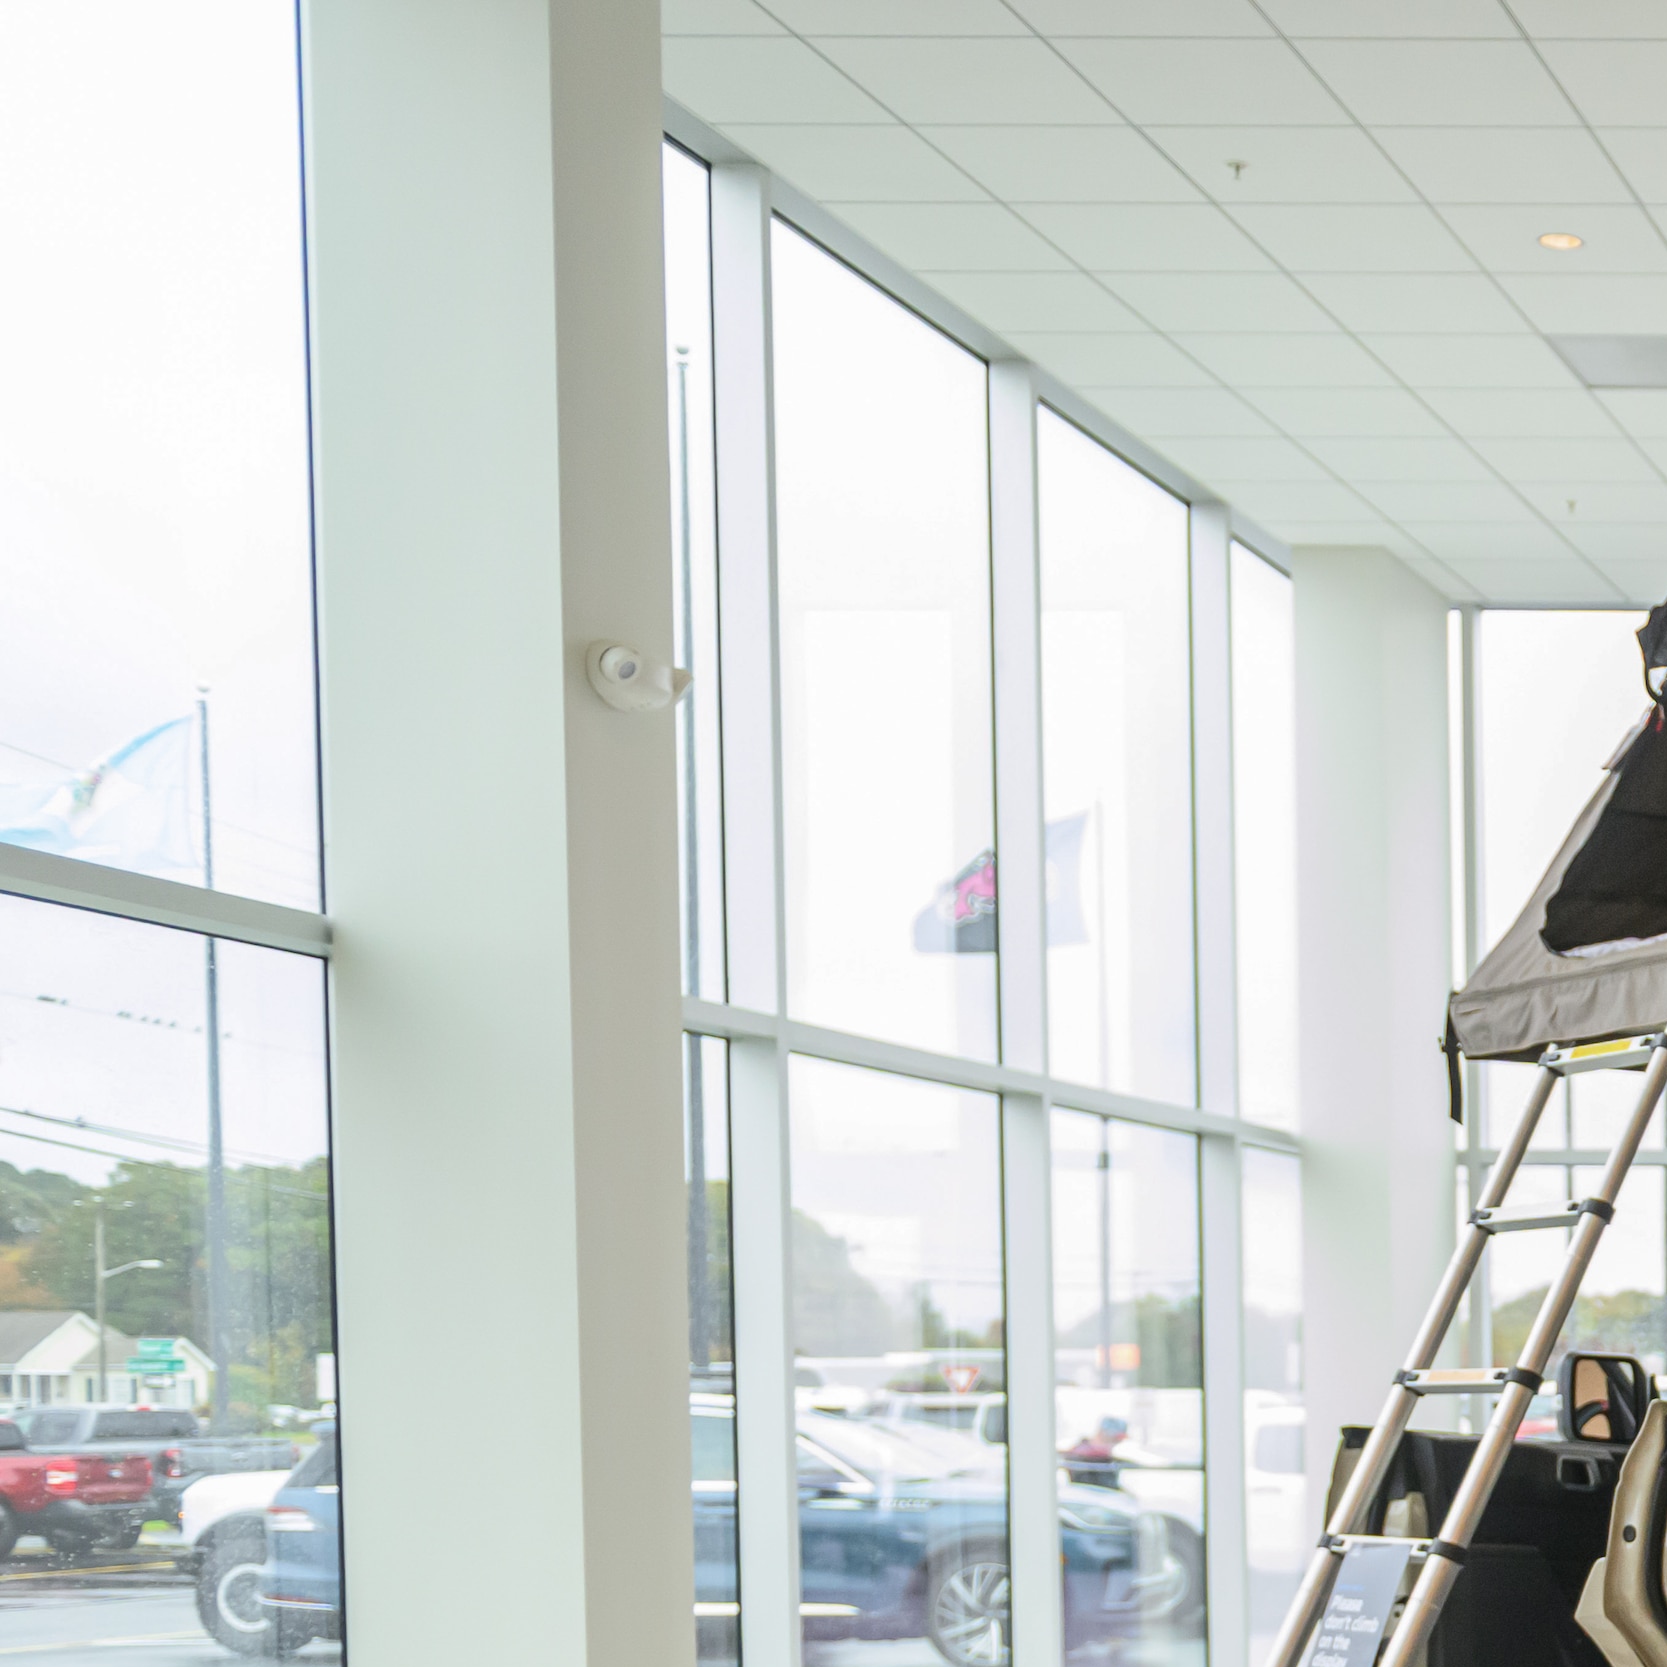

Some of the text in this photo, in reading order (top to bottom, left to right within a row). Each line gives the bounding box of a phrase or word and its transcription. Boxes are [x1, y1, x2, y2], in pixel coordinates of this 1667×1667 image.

[1331, 1594, 1363, 1613] Please
[1324, 1614, 1380, 1634] don't climb
[1318, 1634, 1351, 1650] on the
